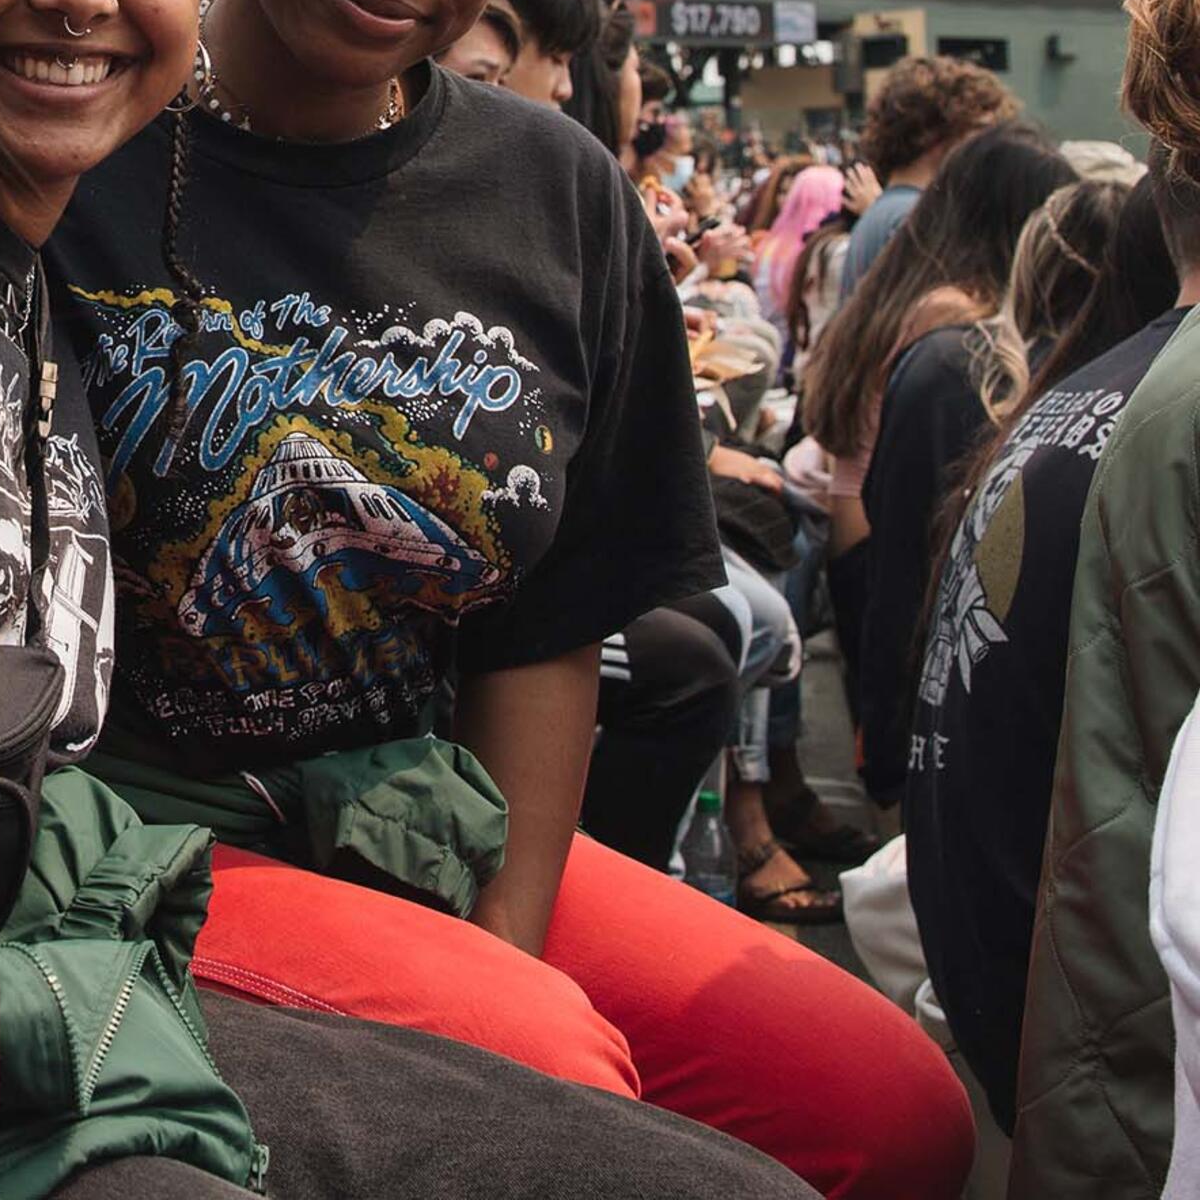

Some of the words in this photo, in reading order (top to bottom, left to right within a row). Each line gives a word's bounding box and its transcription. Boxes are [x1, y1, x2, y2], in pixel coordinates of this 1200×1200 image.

[238, 300, 266, 340] of
[270, 291, 333, 331] The
[103, 326, 522, 490] Mothership
